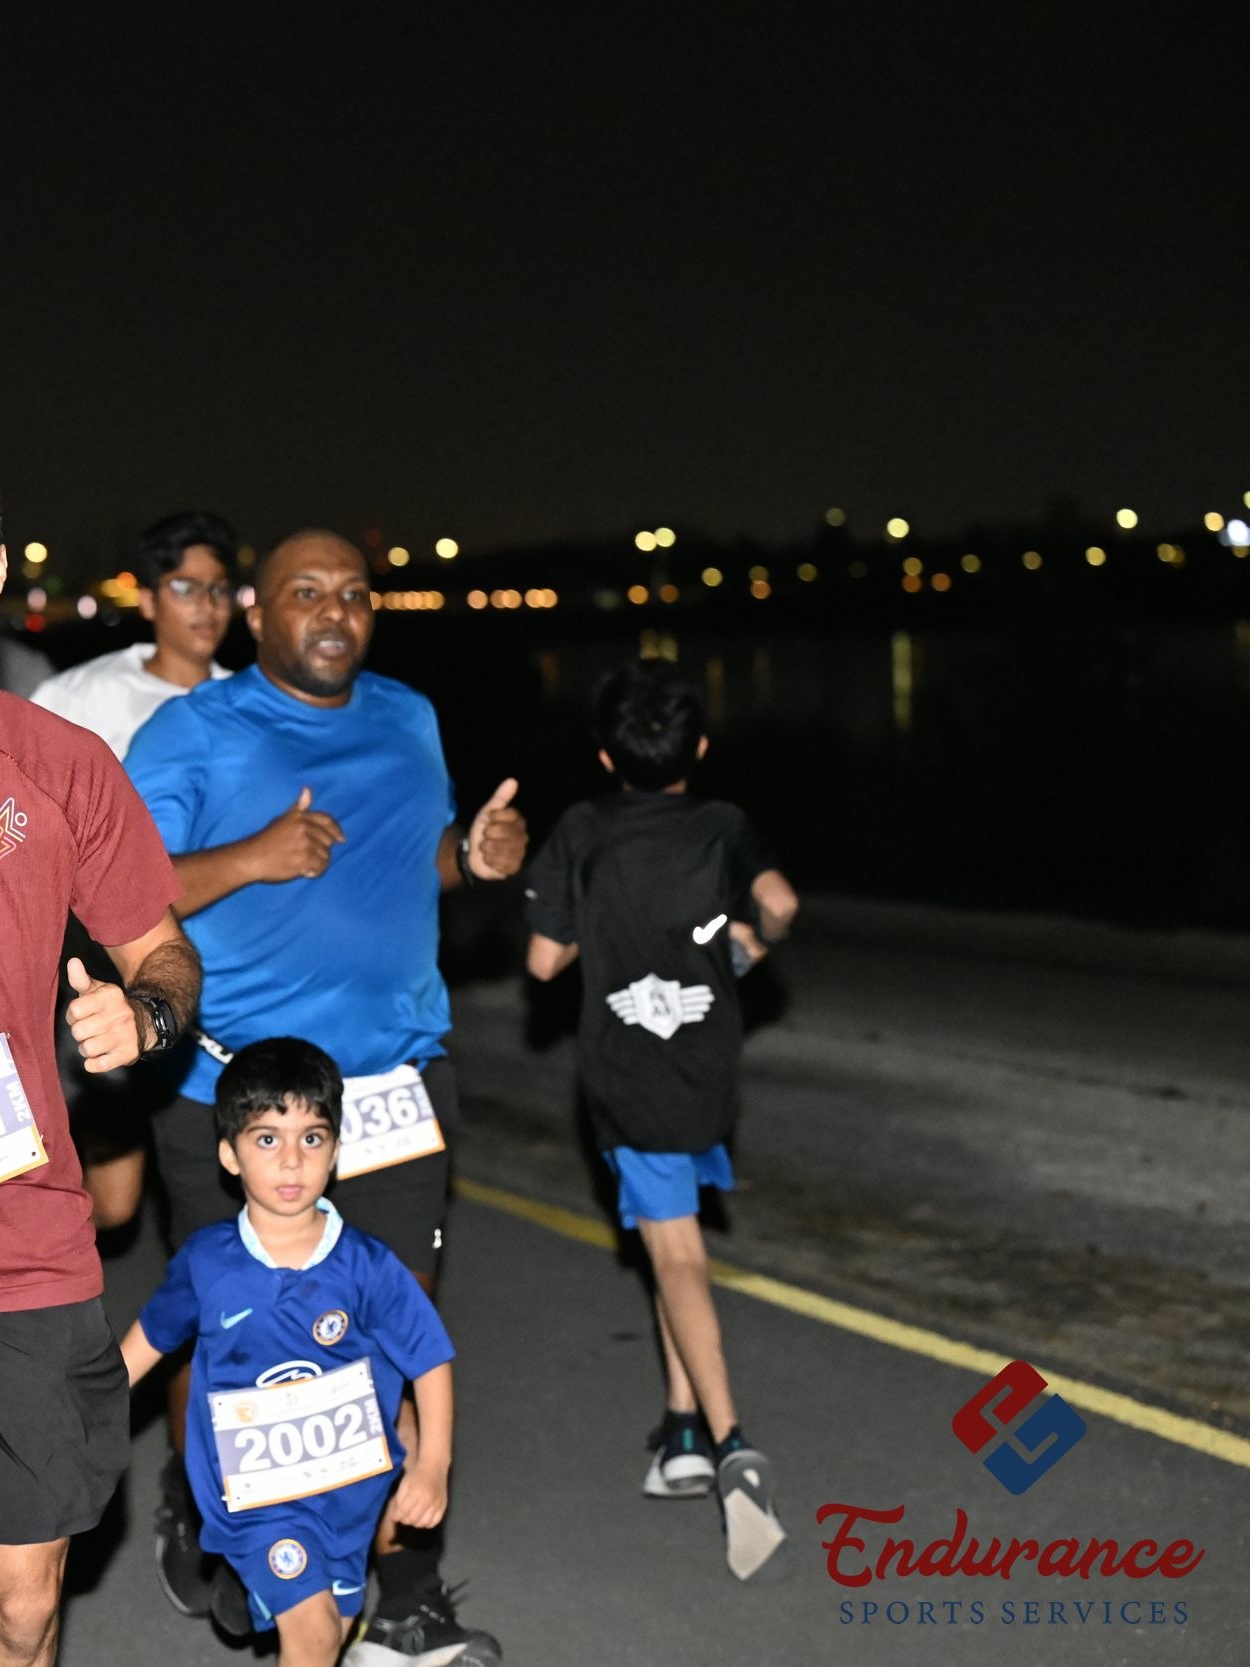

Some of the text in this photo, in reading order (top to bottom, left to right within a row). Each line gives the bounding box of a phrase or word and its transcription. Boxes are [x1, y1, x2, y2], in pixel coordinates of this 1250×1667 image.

[5, 1080, 31, 1122] 2KM
[340, 1087, 418, 1144] 036
[234, 1403, 367, 1473] 2002
